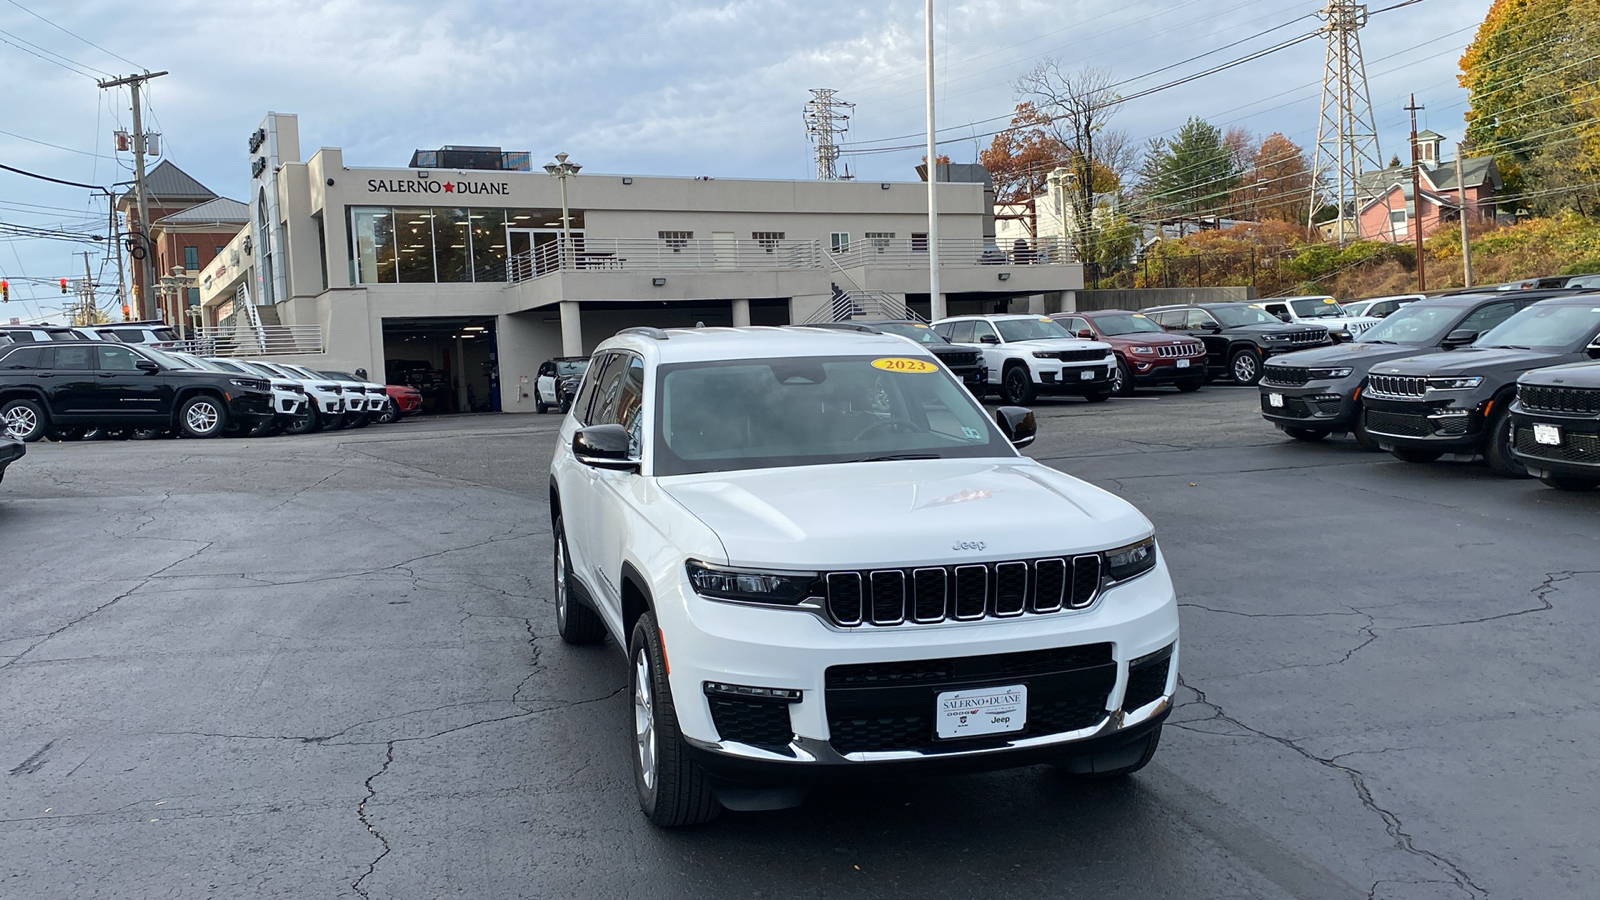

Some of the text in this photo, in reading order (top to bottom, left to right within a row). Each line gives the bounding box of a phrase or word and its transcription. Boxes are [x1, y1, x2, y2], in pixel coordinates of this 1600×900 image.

[368, 179, 509, 194] SALERNO DUANE
[885, 360, 926, 371] 2023
[951, 540, 987, 551] Jeep
[943, 698, 985, 709] SALERNO
[989, 694, 1021, 705] DUANE
[991, 716, 1010, 724] Jeep
